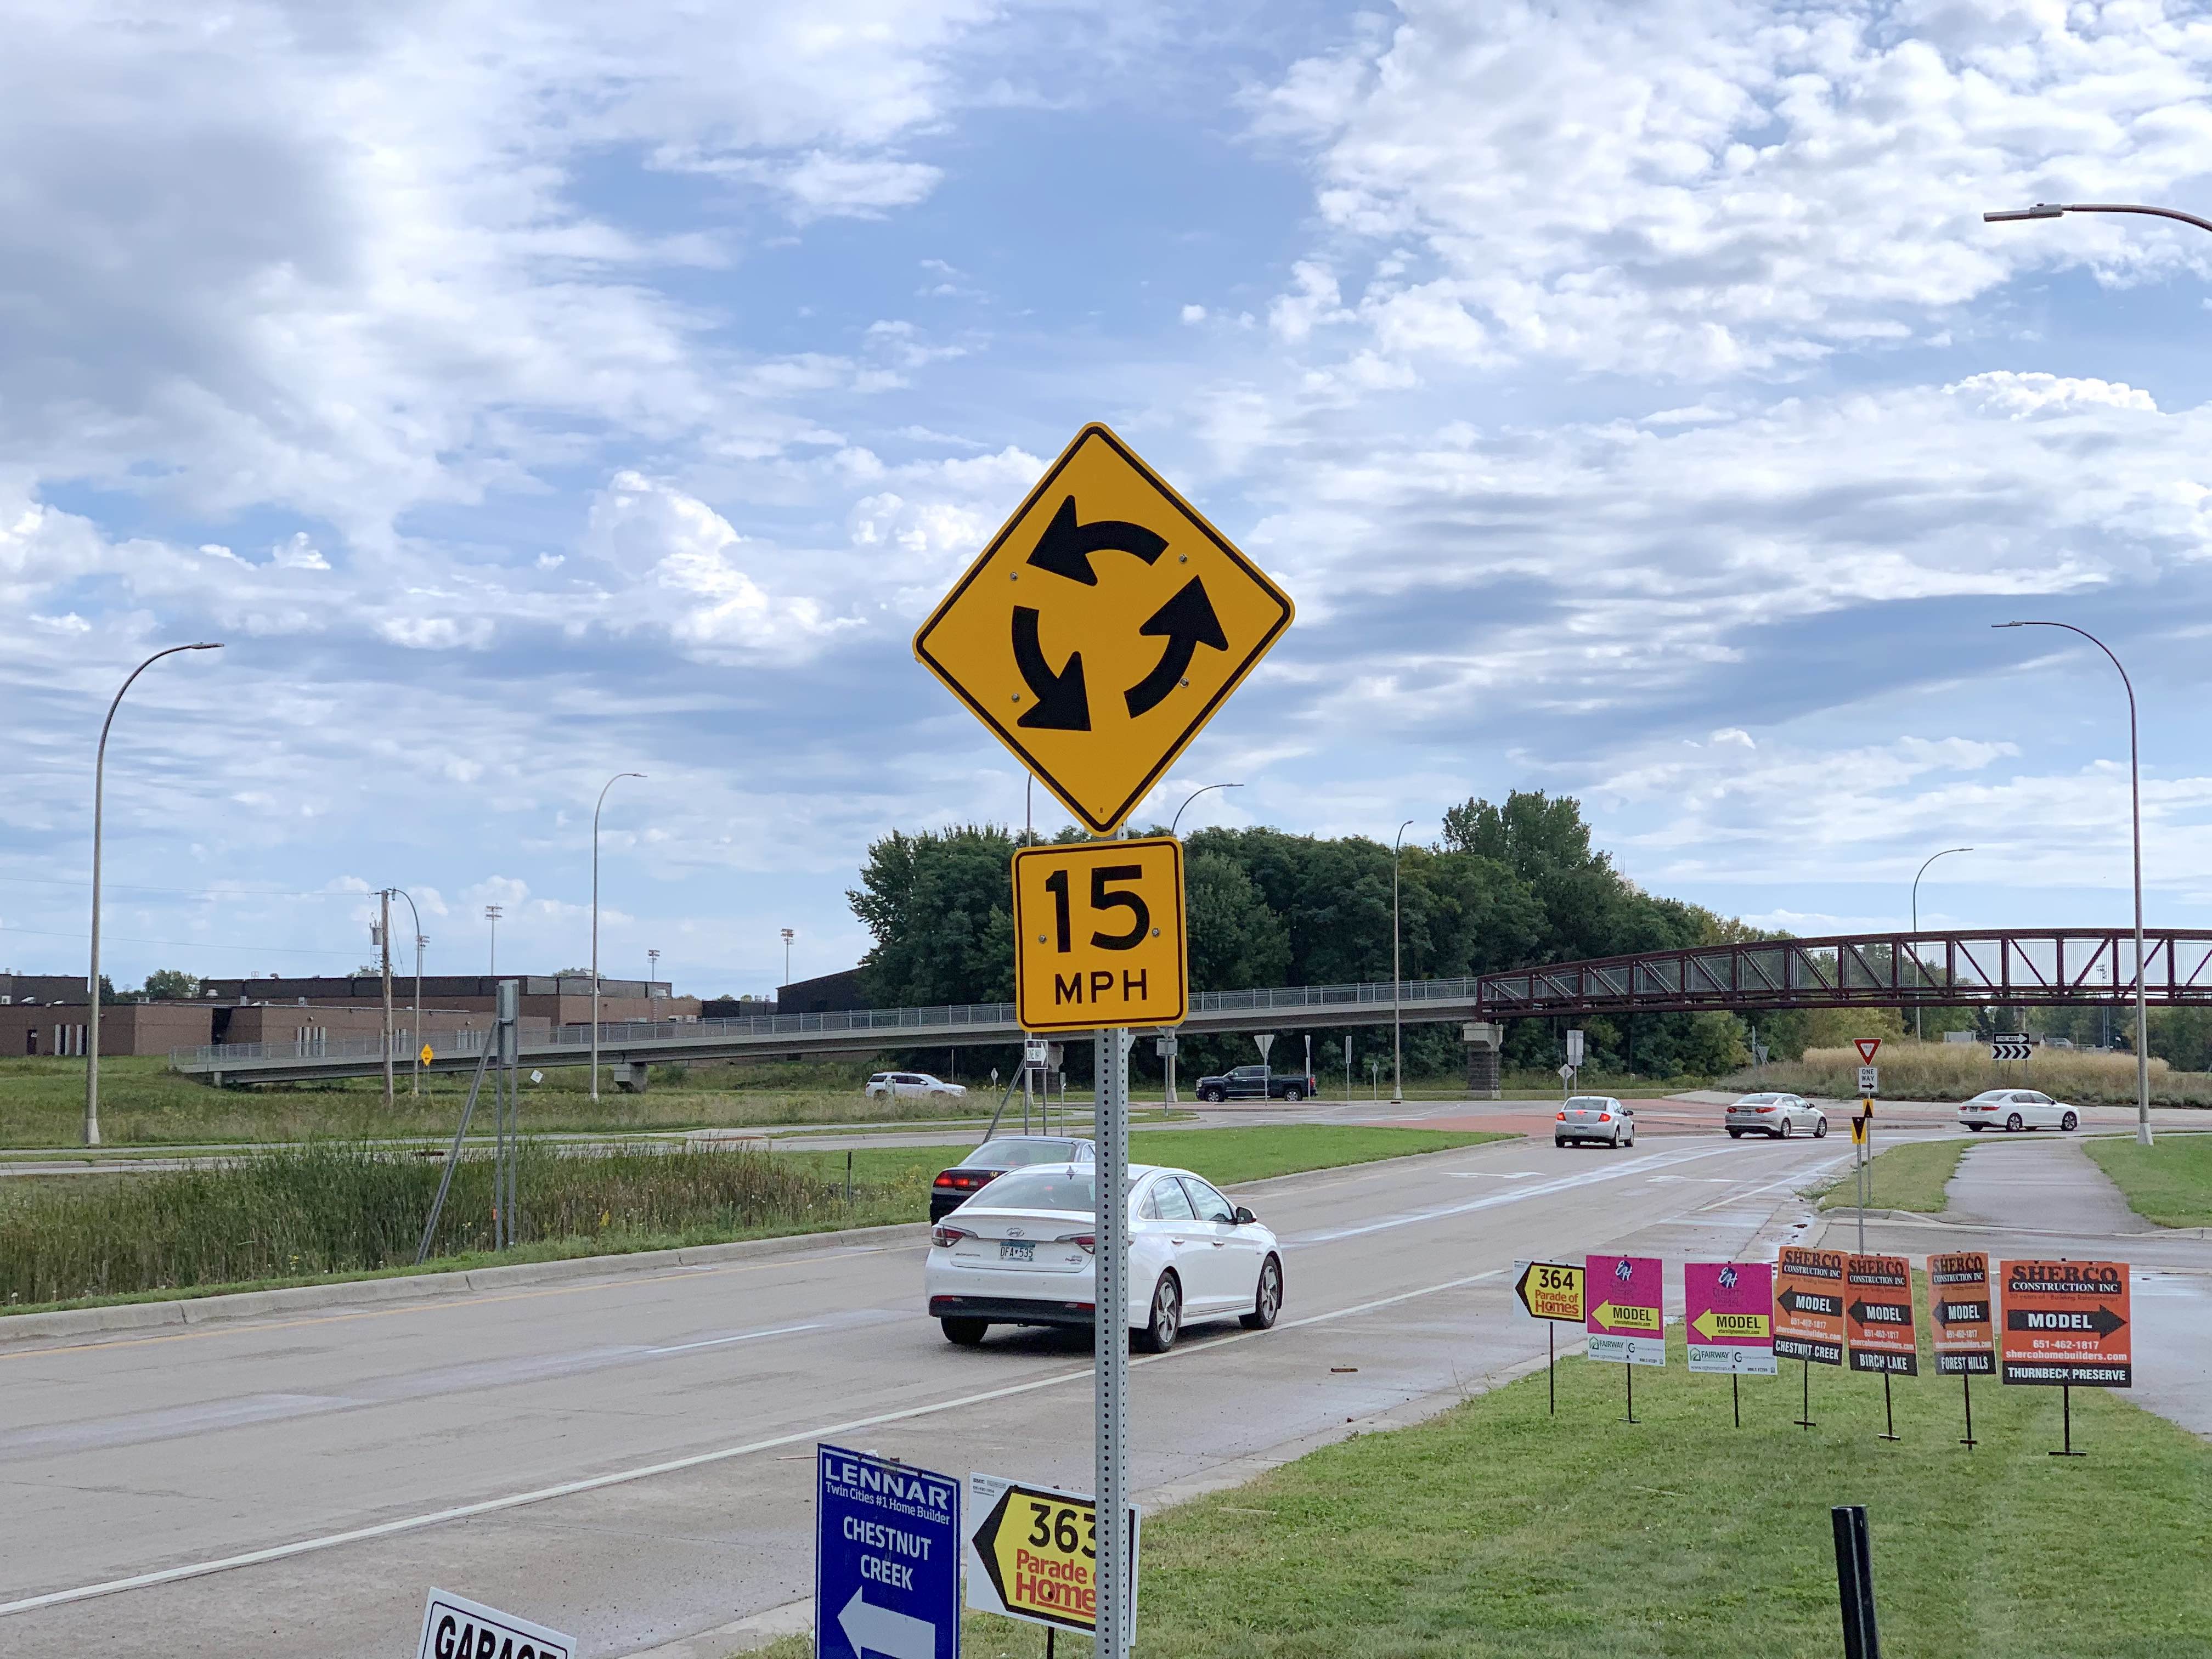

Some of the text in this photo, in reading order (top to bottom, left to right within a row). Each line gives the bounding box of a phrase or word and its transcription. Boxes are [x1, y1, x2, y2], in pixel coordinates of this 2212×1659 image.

[1045, 864, 1150, 953] 15
[1055, 968, 1147, 1005] MPH
[1785, 1250, 1842, 1268] SHERCO
[1933, 1256, 1983, 1273] SHERCO
[1784, 1264, 1828, 1277] CONSTRUCTION
[1848, 1259, 1904, 1275] SHERCO
[2012, 1265, 2119, 1283] SHERCO
[1539, 1268, 1575, 1290] 364
[1849, 1274, 1894, 1284] CONSTRUCTION
[1895, 1277, 1905, 1285] INC
[1934, 1273, 1973, 1283] CONSTRUCTION
[2012, 1282, 2118, 1292] CONSTRUCTION INC
[1535, 1289, 1579, 1303] Parade of
[1796, 1295, 1832, 1312] MODEL
[1535, 1300, 1579, 1314] Homes
[1613, 1307, 1652, 1321] MODEL
[1866, 1306, 1902, 1321] MODEL
[1948, 1305, 1980, 1319] MODEL
[1717, 1316, 1761, 1329] MODEL
[2028, 1313, 2093, 1329] MODEL
[1599, 1340, 1624, 1349] FAIRWAY
[2033, 1339, 2099, 1350] 651-462-1817
[1701, 1350, 1730, 1359] FAIRWAY
[1814, 1345, 1839, 1360] CREEK
[2005, 1349, 2127, 1361] shercohomebuilders.com
[1859, 1353, 1908, 1370] BIRCH LAKE
[1940, 1356, 1989, 1370] FOREST HILLS
[2007, 1367, 2126, 1381] THURNBECK PRESERVE
[825, 1458, 948, 1510] LENNAR
[825, 1481, 950, 1525] Twin Cities #1 Home Builder
[843, 1515, 932, 1561] CHESTNUT
[860, 1554, 913, 1591] CREEK
[1016, 1548, 1087, 1584] Parade
[1015, 1571, 1096, 1612] Home
[435, 1615, 557, 1659] GAR
